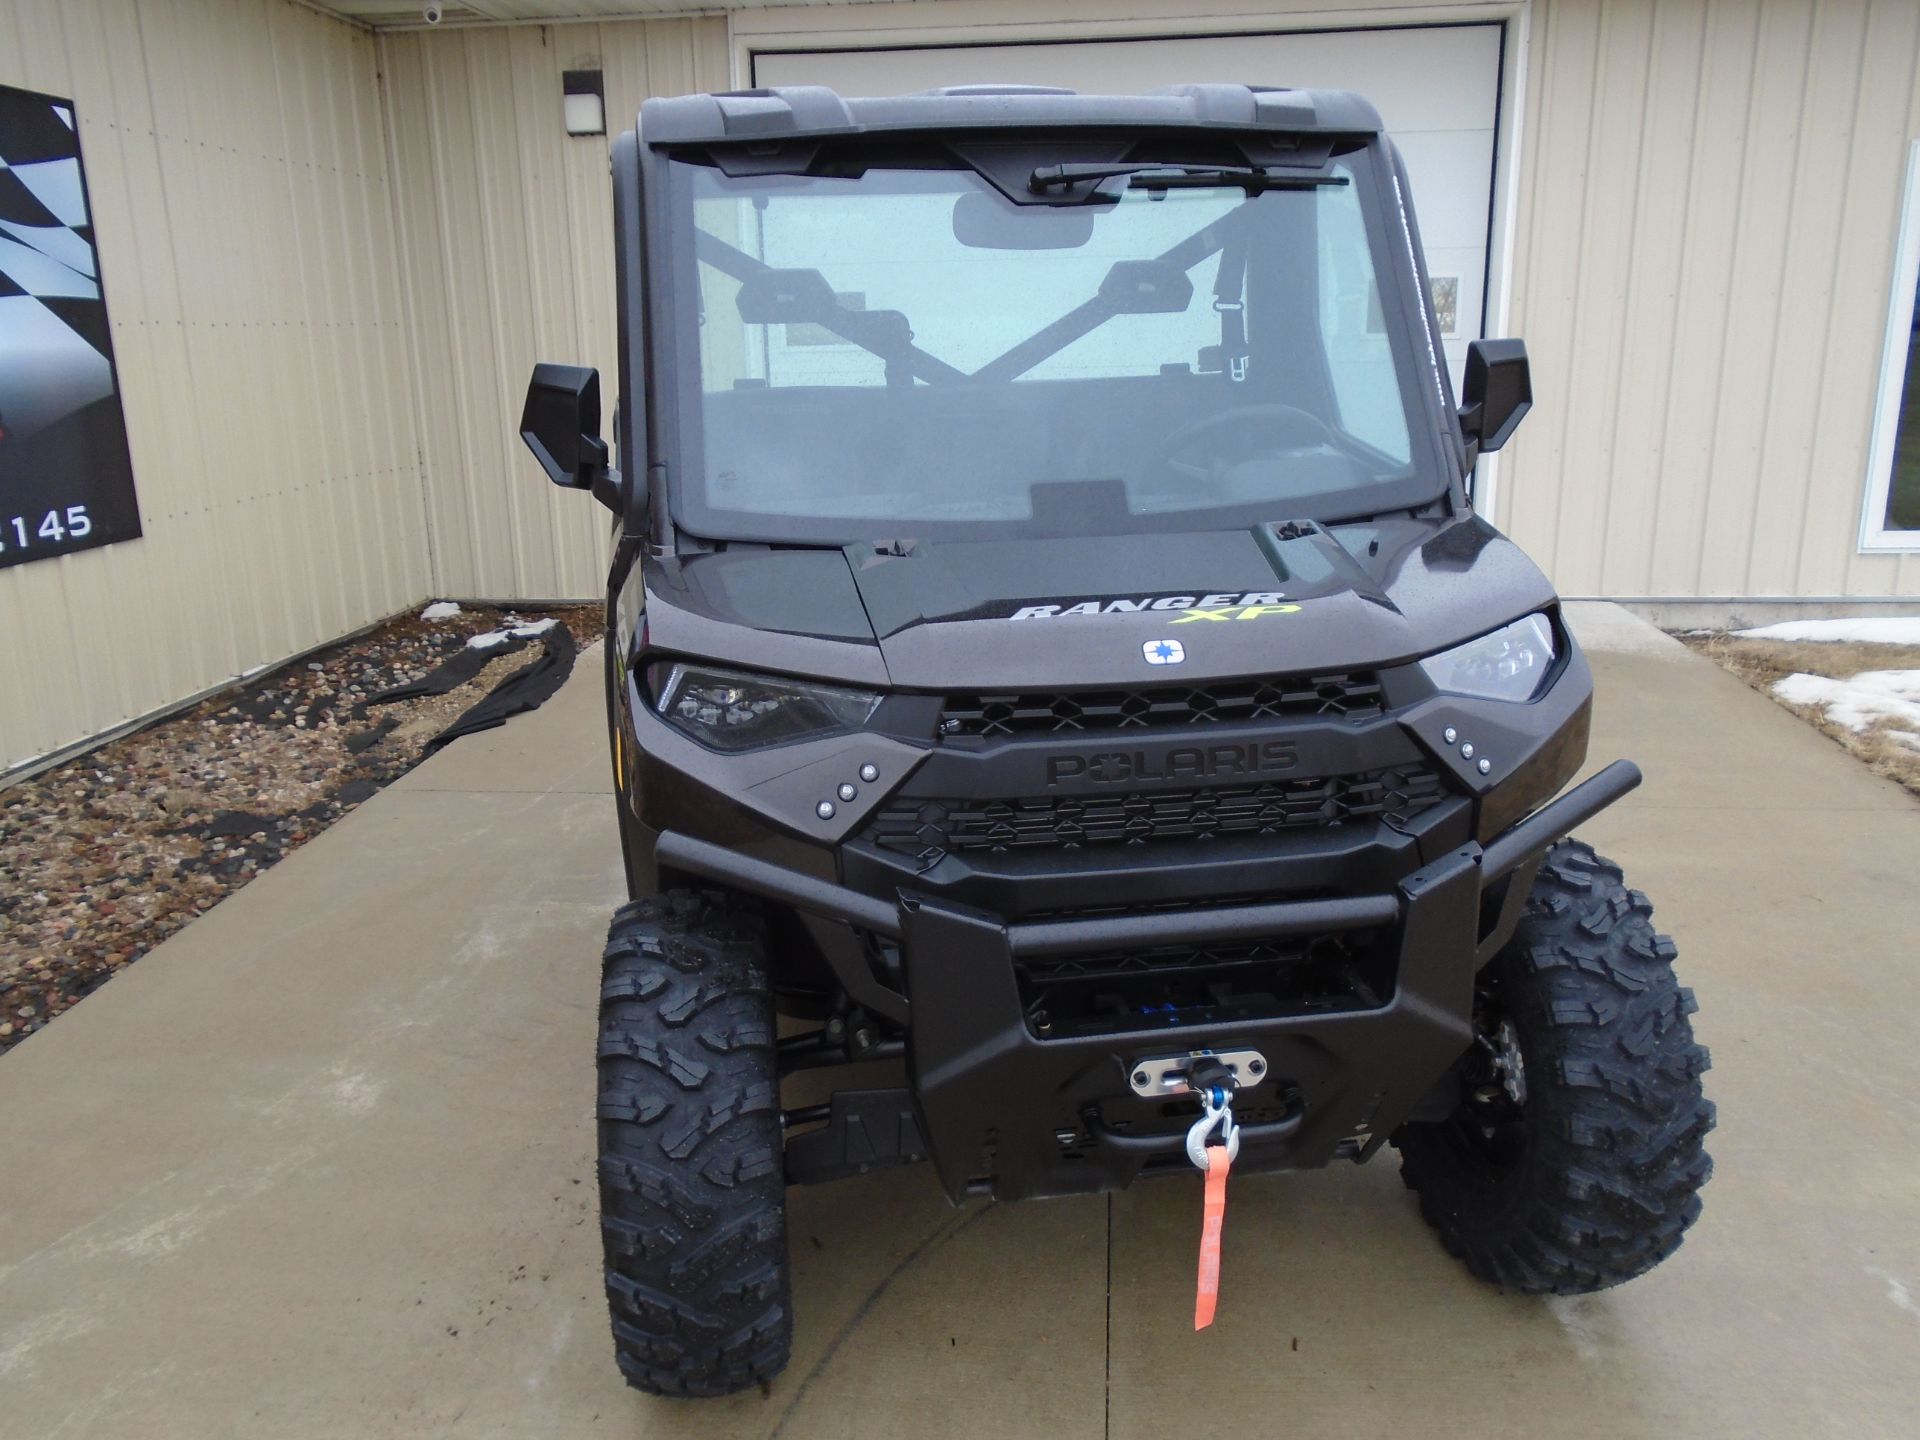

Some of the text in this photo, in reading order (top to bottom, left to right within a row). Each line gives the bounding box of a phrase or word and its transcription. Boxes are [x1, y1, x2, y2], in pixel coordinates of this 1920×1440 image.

[0, 505, 92, 552] 145
[1009, 592, 1285, 621] RANGER
[1167, 604, 1302, 624] XP
[1046, 740, 1298, 786] POLARIS
